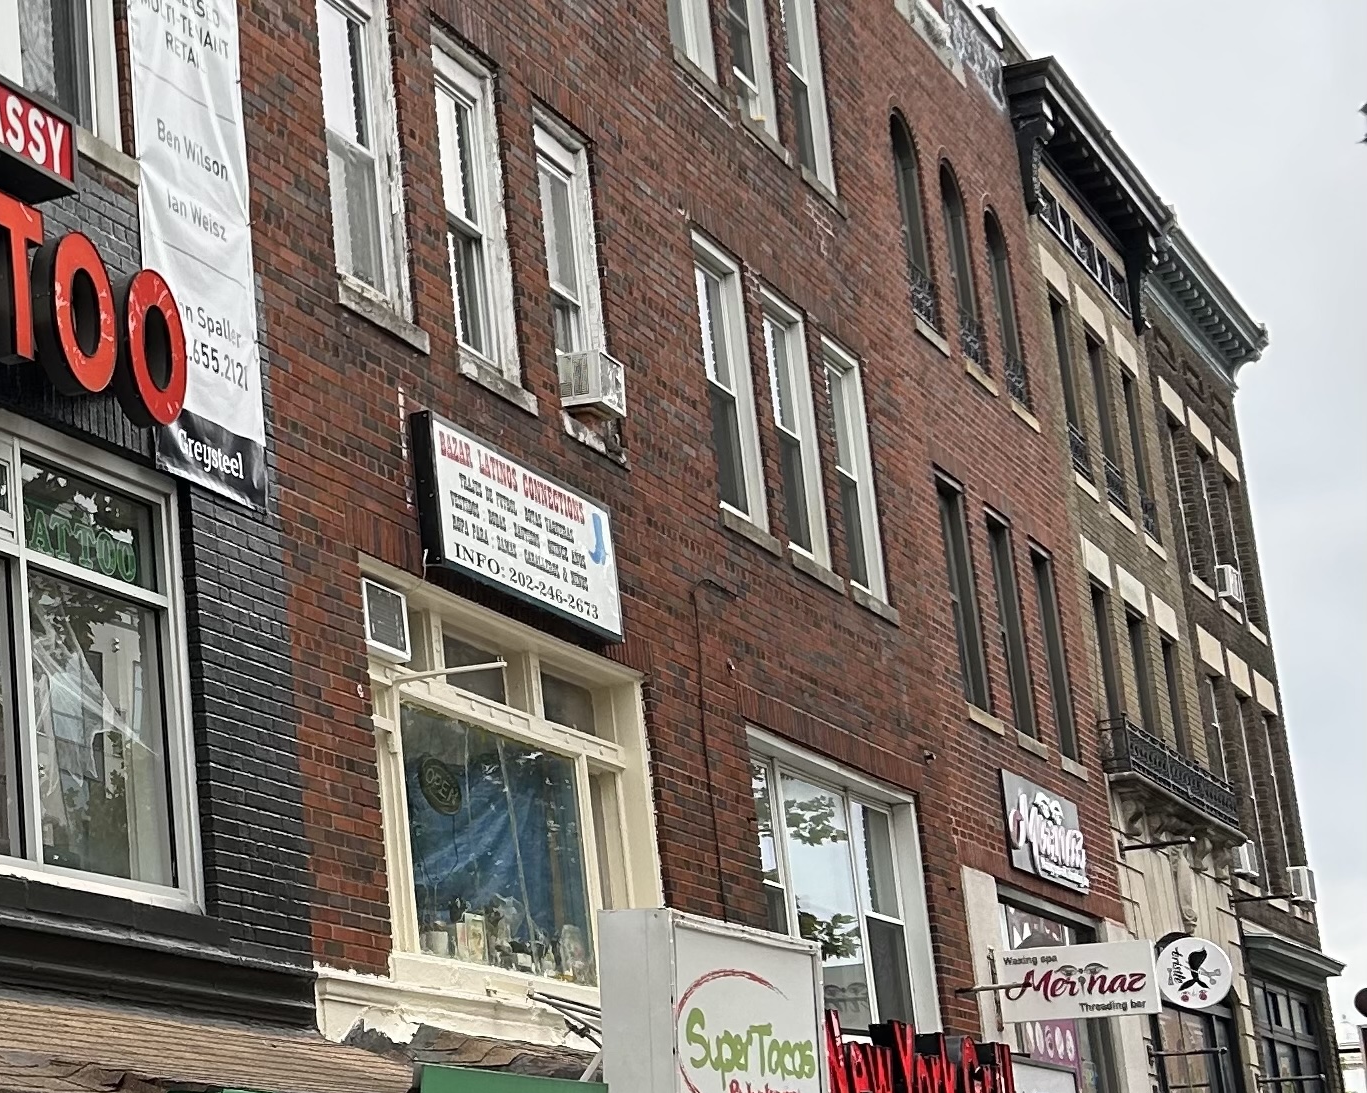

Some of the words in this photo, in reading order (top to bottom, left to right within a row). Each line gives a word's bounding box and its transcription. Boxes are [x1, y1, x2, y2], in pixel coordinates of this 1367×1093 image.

[157, 118, 181, 156] Ben
[184, 135, 229, 182] Wilson
[167, 193, 190, 224] Ian
[191, 204, 228, 243] Weisz
[177, 428, 245, 480] Greysteel
[439, 431, 474, 468] BAZAR
[477, 449, 518, 492] LATINOS
[523, 473, 585, 524] CONNECTIONS
[454, 542, 506, 578] INFO:
[509, 567, 599, 620] 202-246-2673
[1079, 1002, 1128, 1014] Threading
[1130, 999, 1147, 1010] bar
